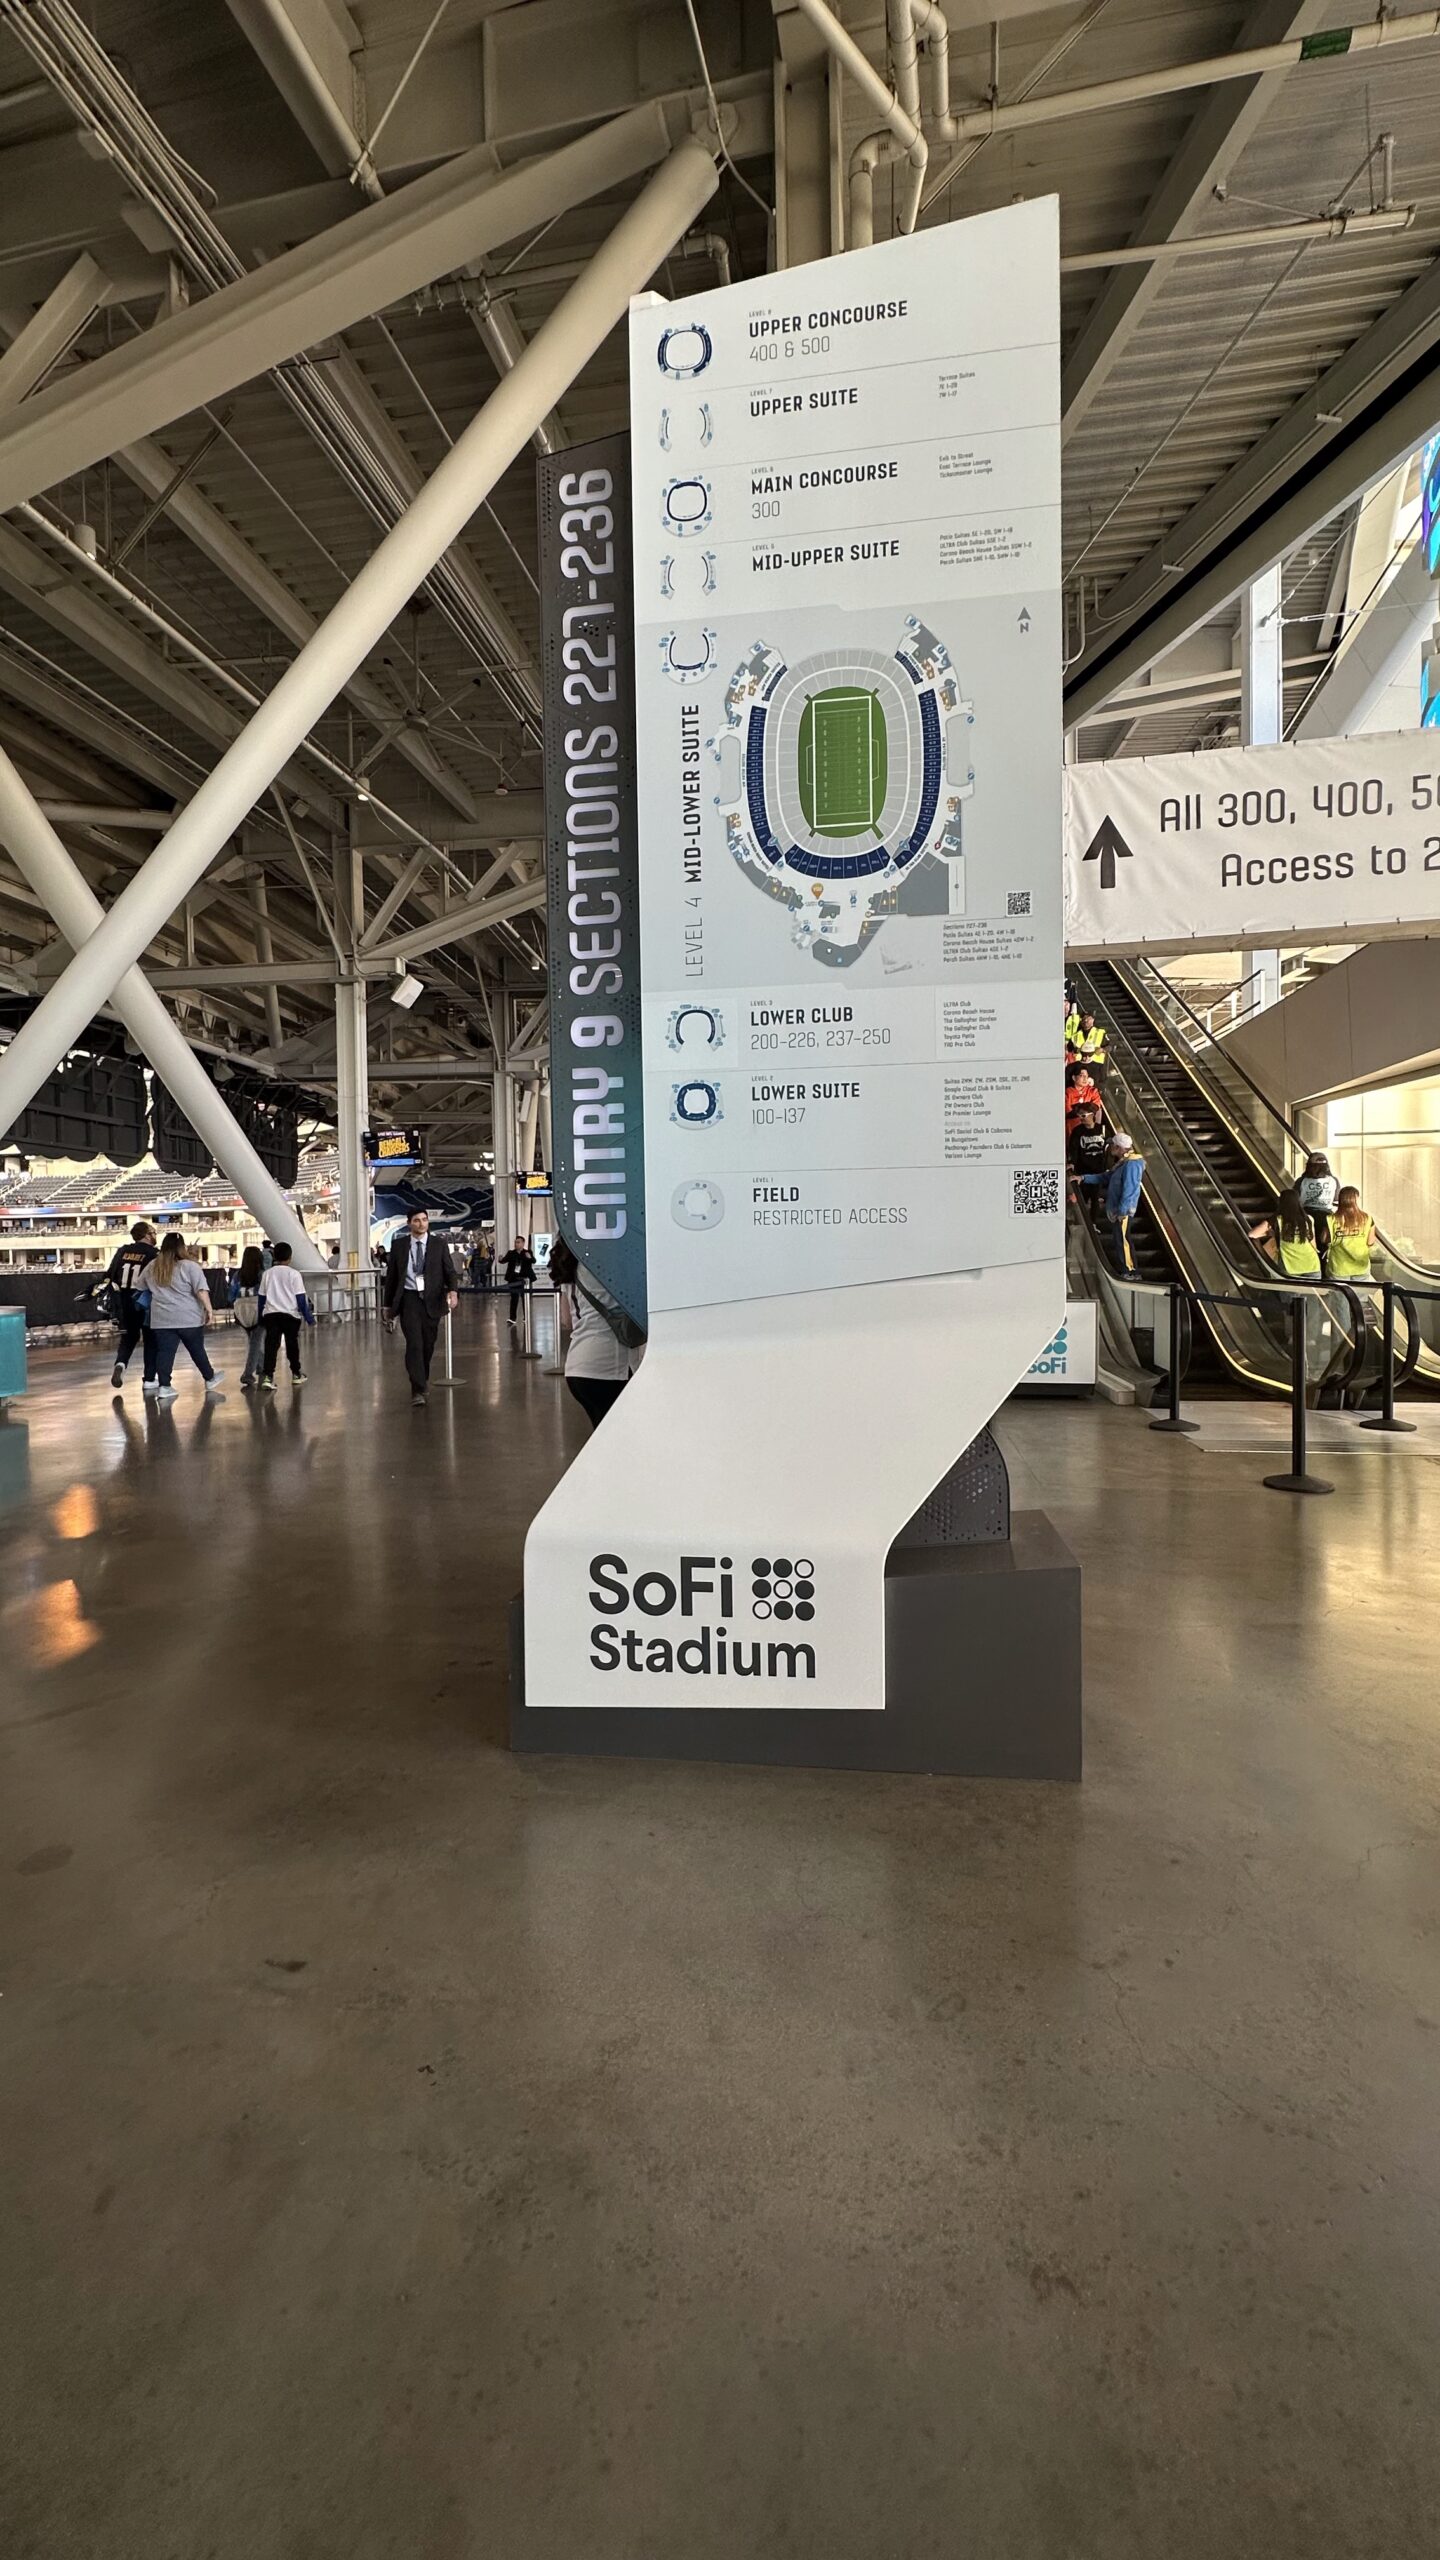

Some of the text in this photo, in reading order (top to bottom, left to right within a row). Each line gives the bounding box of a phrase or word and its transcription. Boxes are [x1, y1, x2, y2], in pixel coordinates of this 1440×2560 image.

[750, 300, 908, 338] UPPER CONCOURSE
[750, 336, 830, 362] 400 & 500
[750, 388, 858, 417] UPPER SUITE
[752, 462, 898, 494] MAIN CONCOURSE
[752, 500, 780, 519] 300
[752, 540, 900, 571] MID-UPPER SUITE
[1020, 622, 1029, 633] N
[1160, 775, 1440, 832] All 300, 400, 5
[682, 704, 703, 976] LEVEL 4 MID-LOWER SUITE
[558, 468, 627, 1240] ENTRY 9 SECTIONS 227-236
[1221, 852, 1353, 888] Access
[1370, 846, 1406, 875] to
[751, 1007, 853, 1026] LOWER CLUB
[826, 1028, 891, 1046] 237-250
[752, 1083, 860, 1101] LOWER SUITE
[752, 1108, 806, 1125] 100-137
[753, 1187, 800, 1202] FIELD
[1308, 1182, 1329, 1190] CSC
[754, 1207, 908, 1226] RESTRICTED ACCESS
[121, 1263, 141, 1288] 11
[589, 1554, 733, 1618] SoFi
[590, 1624, 816, 1678] Stadium
